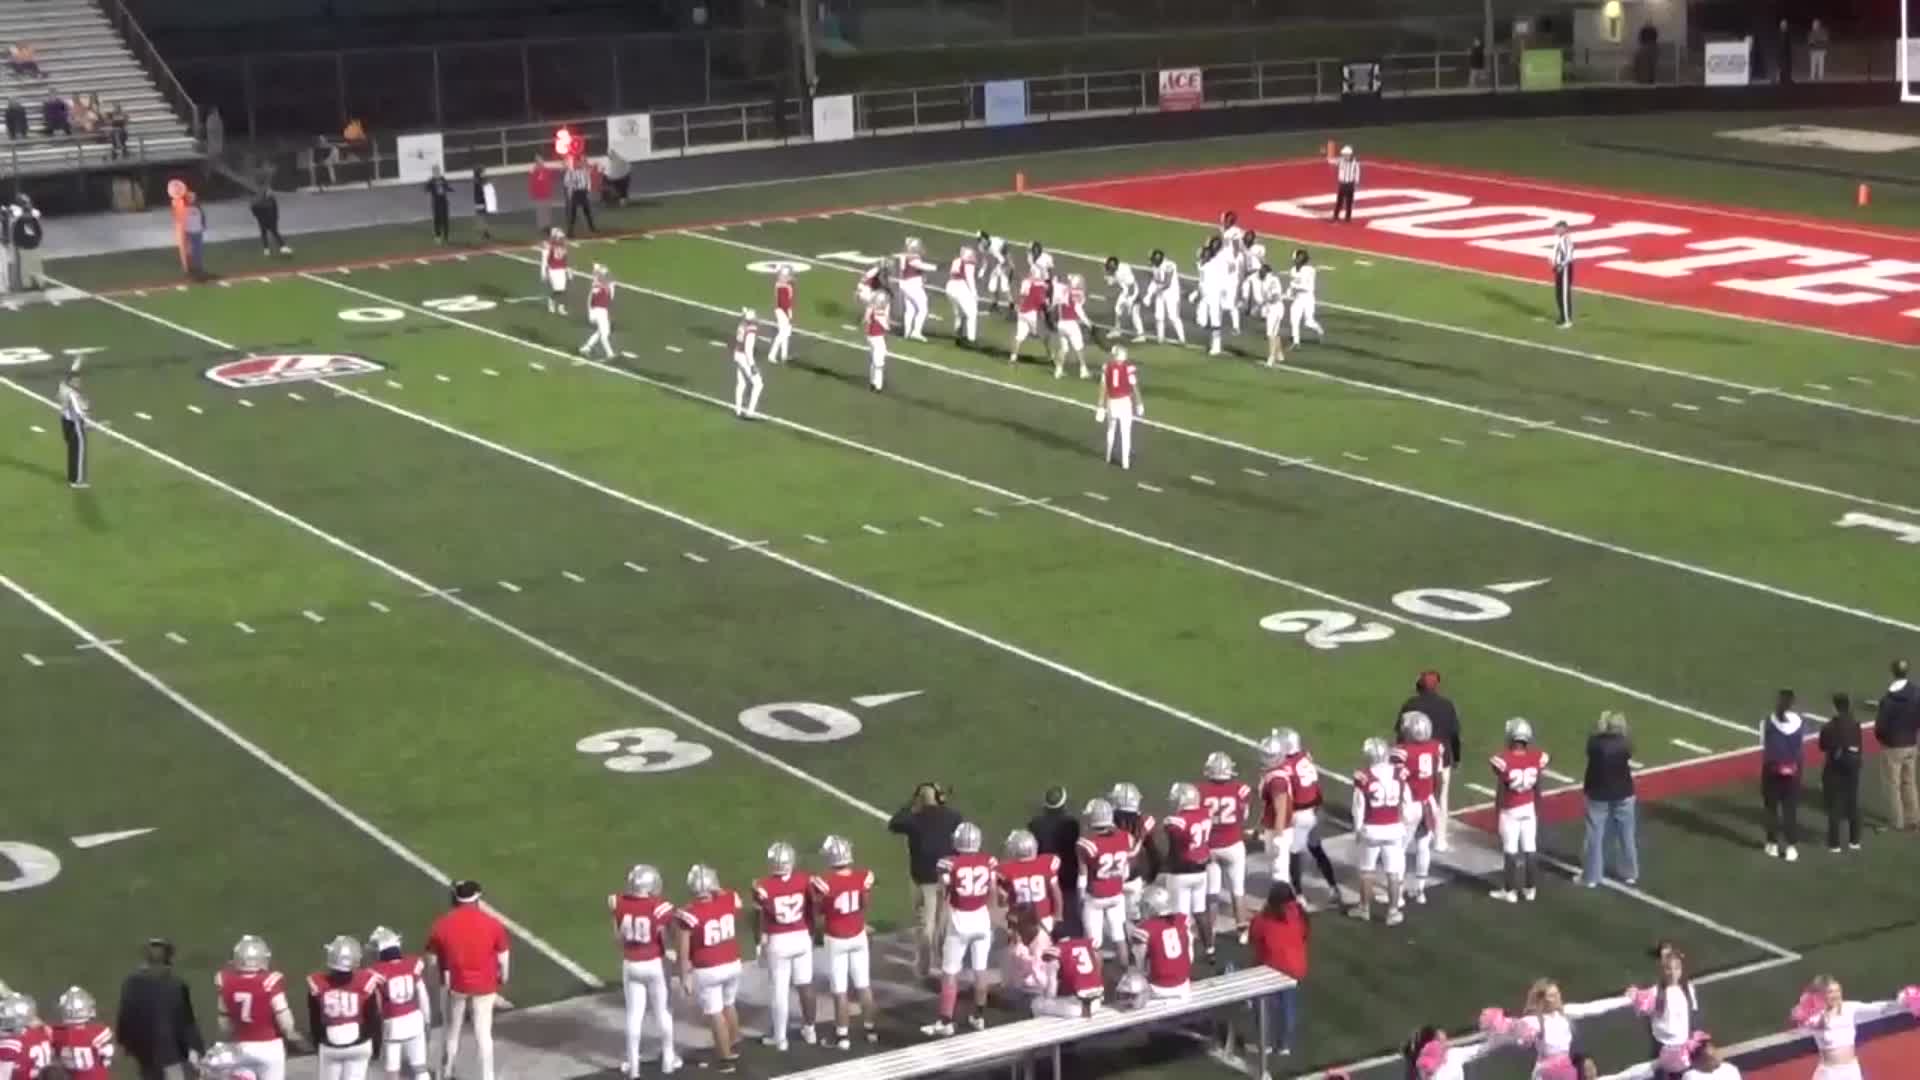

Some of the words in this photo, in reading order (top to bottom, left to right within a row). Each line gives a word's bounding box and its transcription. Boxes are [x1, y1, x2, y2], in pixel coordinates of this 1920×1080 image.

[1254, 188, 1920, 318] OOLTE
[1112, 369, 1121, 388] 1
[1418, 753, 1433, 778] 9
[1204, 797, 1237, 824] 22
[1097, 851, 1129, 879] 23
[956, 866, 990, 896] 32
[1012, 875, 1046, 903] 59
[774, 893, 804, 924] 52
[834, 891, 860, 915] 41
[1072, 947, 1093, 974] 3
[234, 992, 254, 1023] 7
